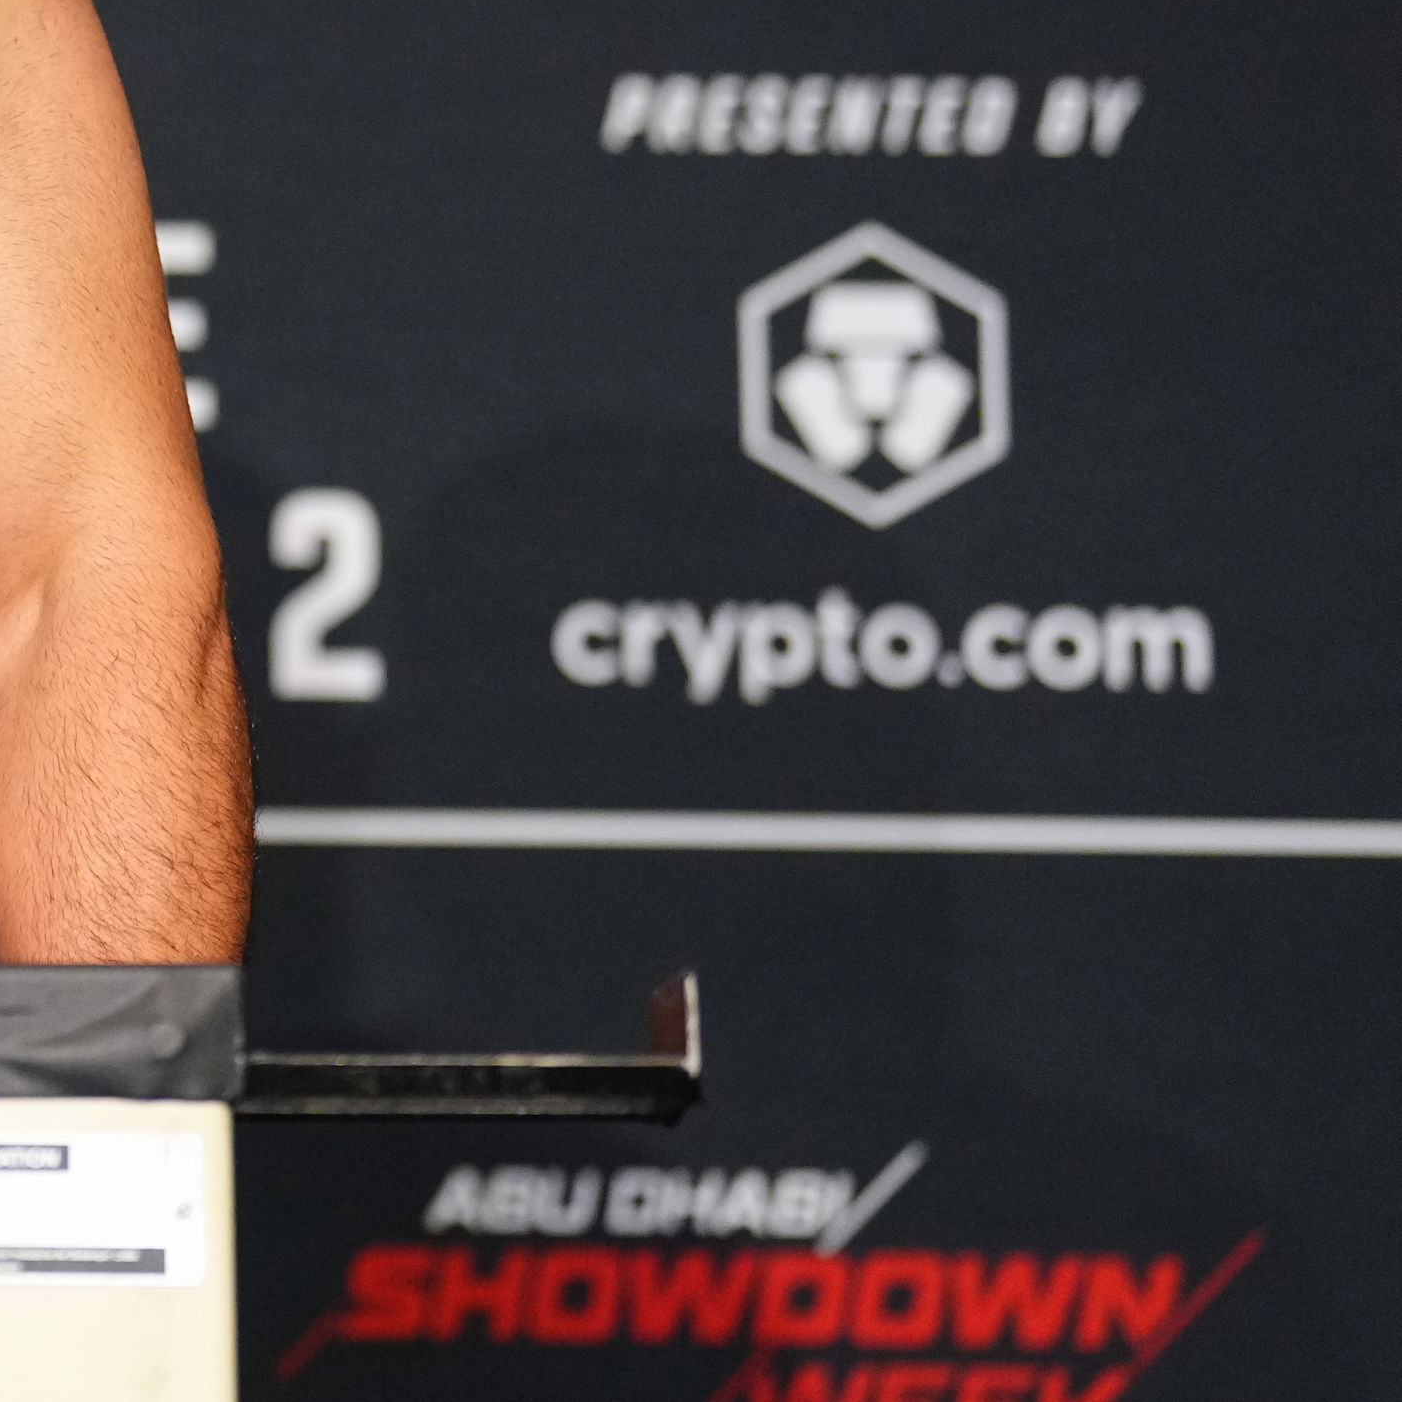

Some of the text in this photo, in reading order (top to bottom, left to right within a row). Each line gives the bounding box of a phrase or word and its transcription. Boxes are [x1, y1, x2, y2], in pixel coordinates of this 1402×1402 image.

[599, 71, 1143, 158] PRESENTED BY
[269, 487, 387, 702] 2
[550, 586, 1215, 705] crypto.com
[423, 1165, 856, 1238] ABU DHABI
[345, 1246, 1184, 1350] SHOWDOWN
